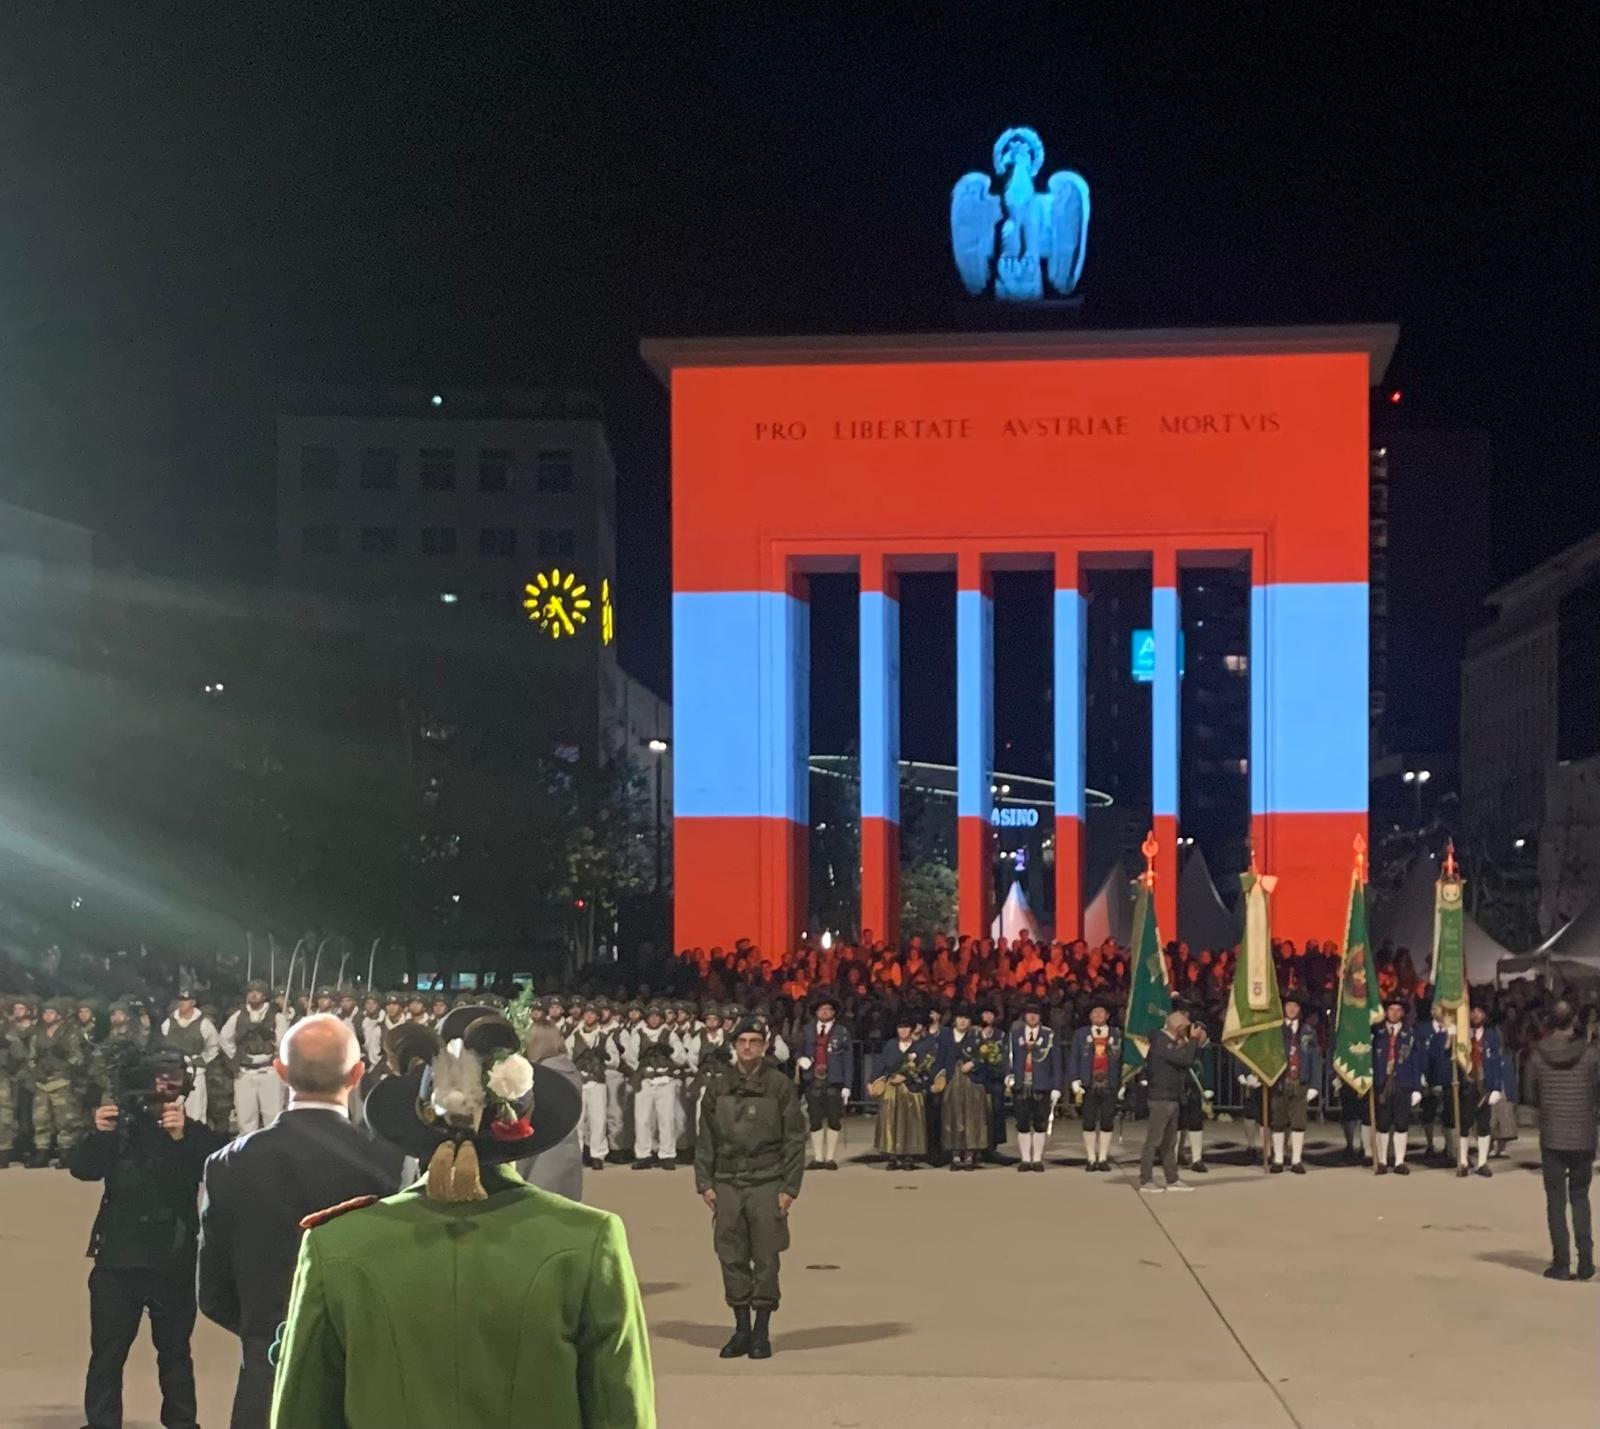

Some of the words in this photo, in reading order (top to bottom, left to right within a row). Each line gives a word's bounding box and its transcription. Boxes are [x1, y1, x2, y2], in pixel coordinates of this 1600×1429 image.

[755, 421, 807, 441] PRO
[834, 418, 974, 440] LIBERTATE
[1002, 415, 1129, 437] AVSTRIAE
[1160, 413, 1280, 434] MORTVIS
[991, 807, 1038, 827] ASINO
